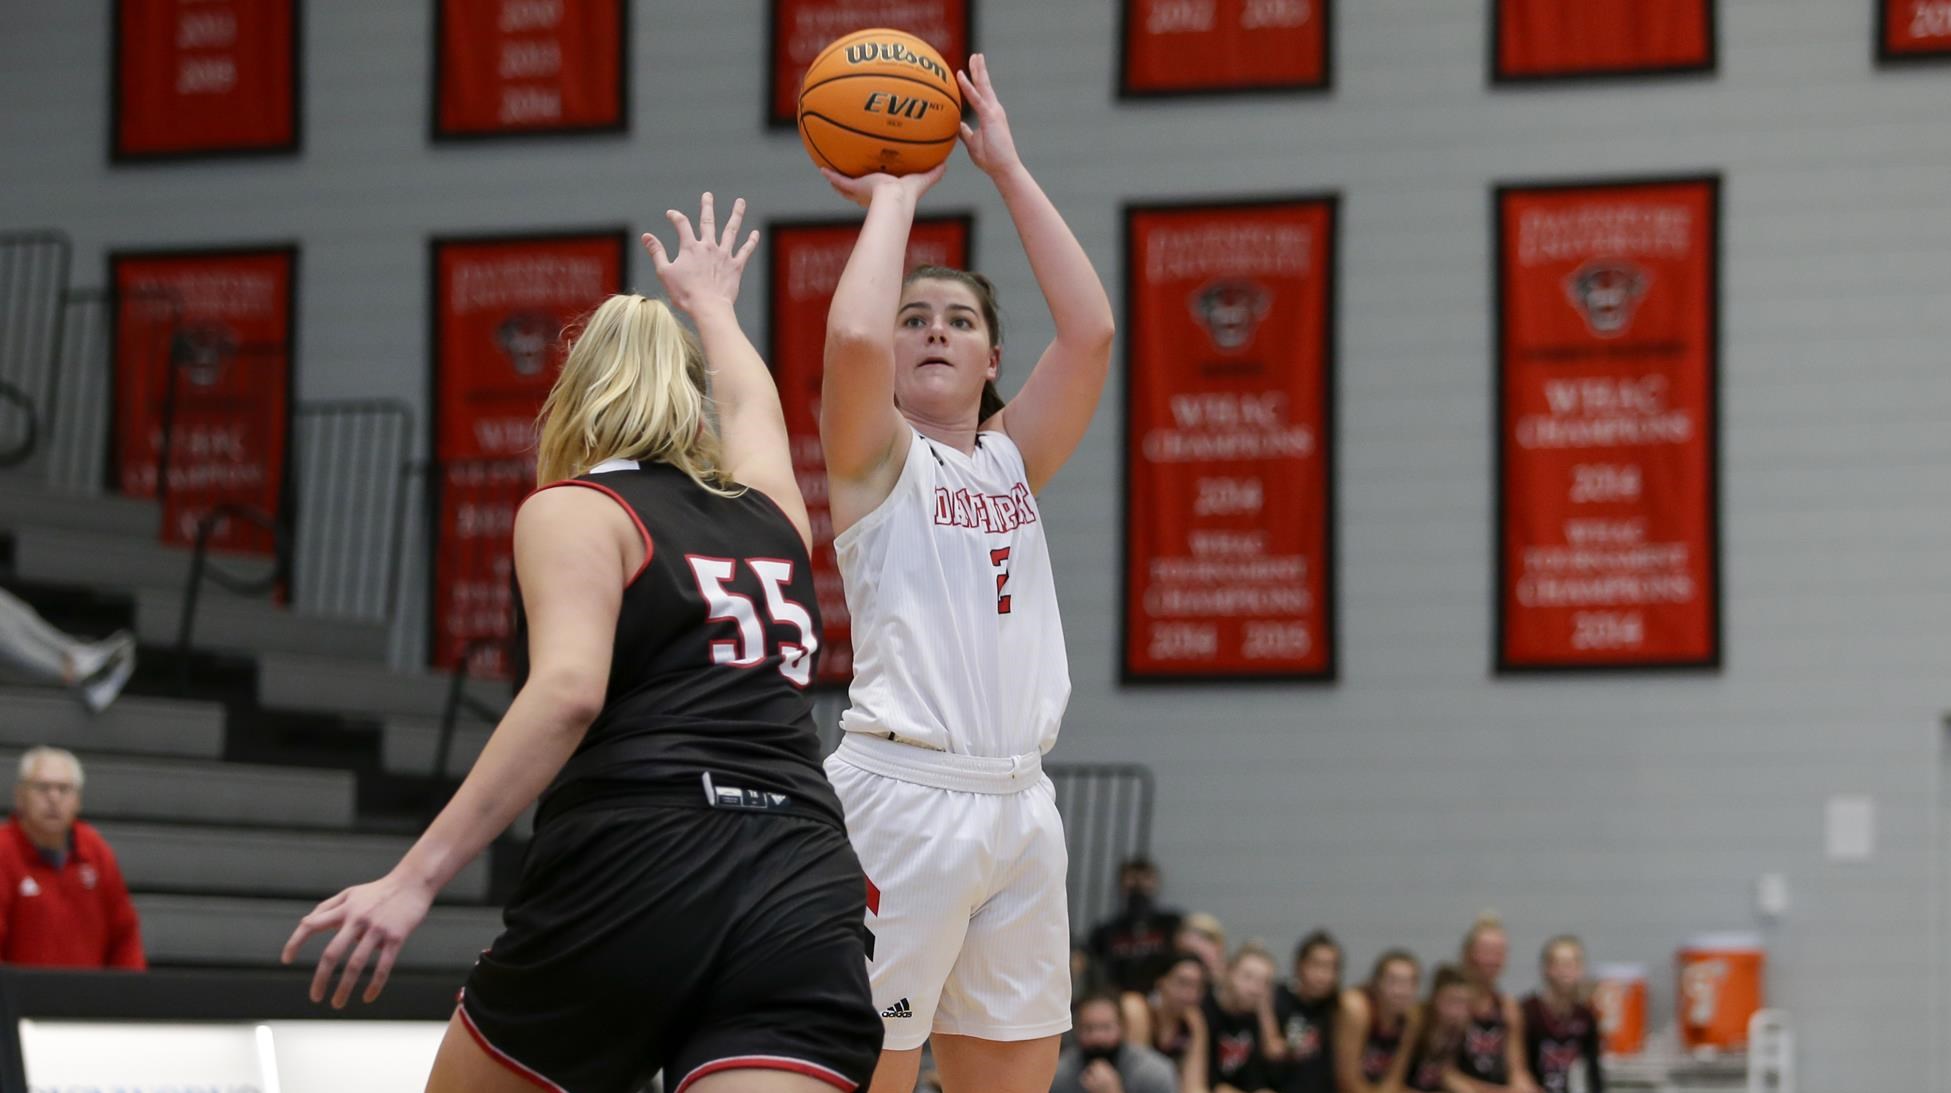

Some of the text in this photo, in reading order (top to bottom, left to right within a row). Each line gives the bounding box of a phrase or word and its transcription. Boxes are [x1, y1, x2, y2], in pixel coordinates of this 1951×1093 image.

[845, 43, 947, 83] Wilson
[864, 92, 928, 120] EVO
[990, 547, 1011, 615] 2
[685, 554, 818, 689] 55
